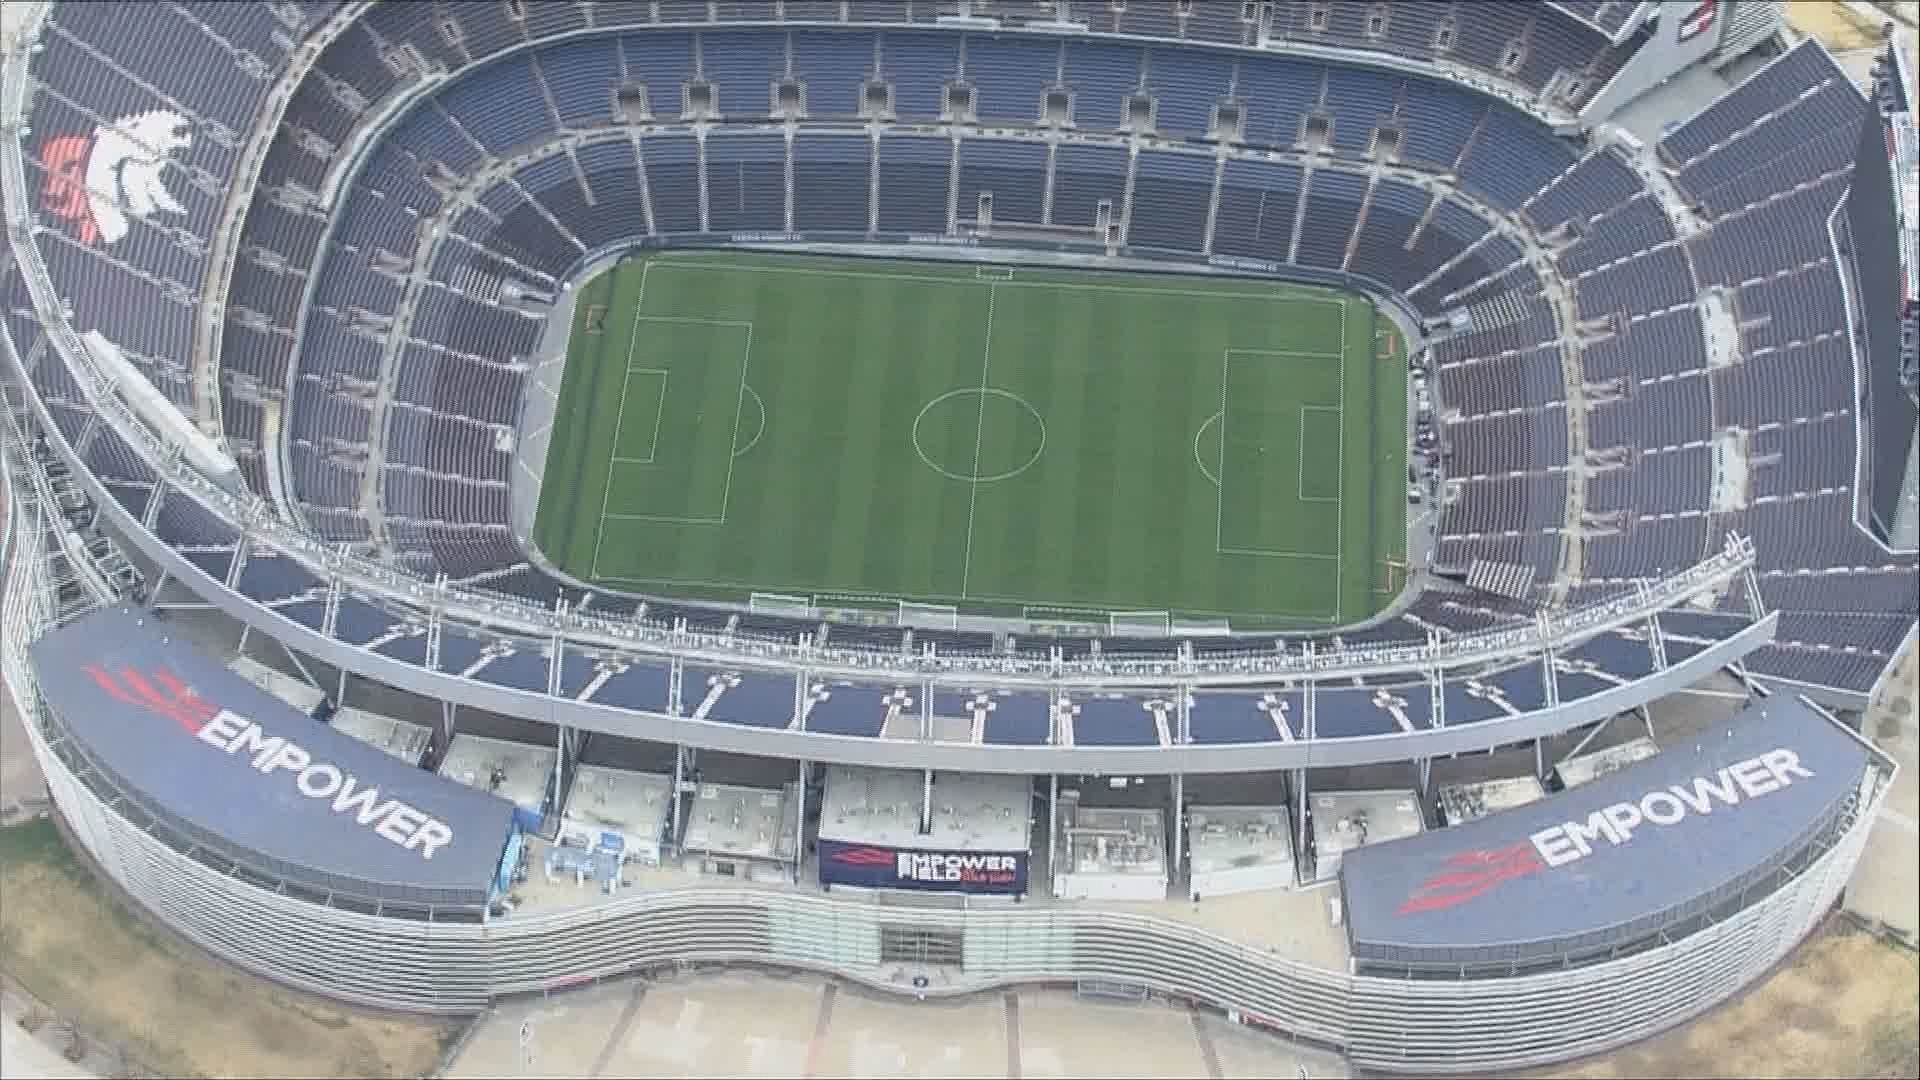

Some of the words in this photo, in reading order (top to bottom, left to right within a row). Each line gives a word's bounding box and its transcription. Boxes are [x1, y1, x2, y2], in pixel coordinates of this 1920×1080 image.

[197, 709, 453, 859] EMPOWER
[1530, 749, 1816, 868] EMPOWER
[897, 853, 1017, 870] EMPOWER
